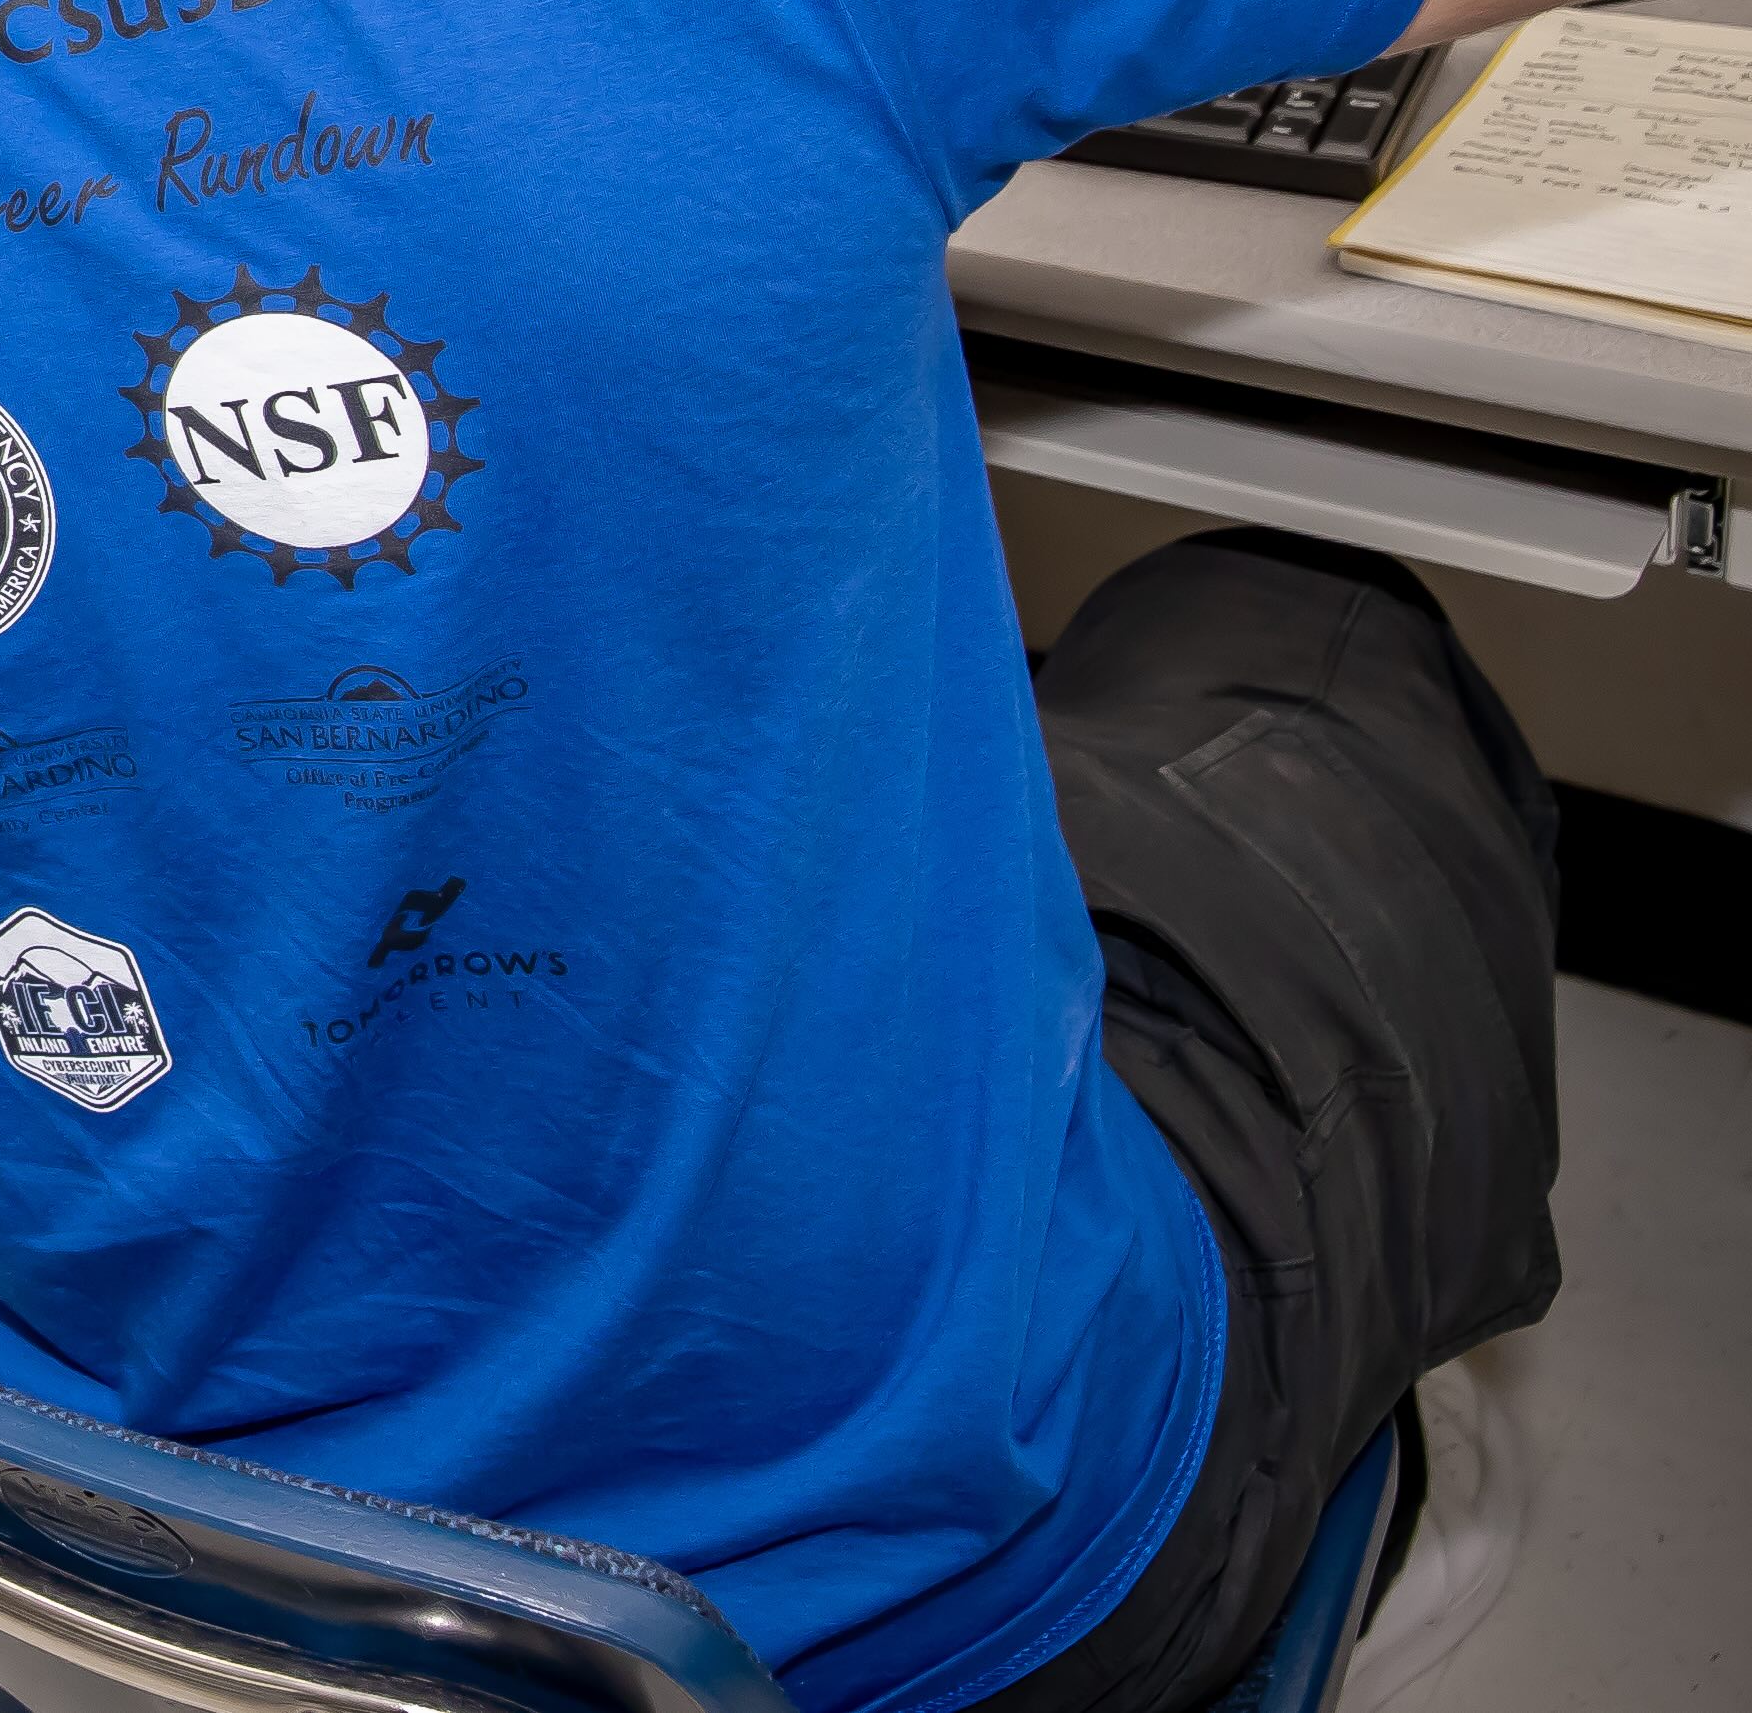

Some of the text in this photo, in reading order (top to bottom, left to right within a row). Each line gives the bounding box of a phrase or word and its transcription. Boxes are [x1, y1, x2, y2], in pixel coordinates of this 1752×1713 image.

[156, 90, 434, 212] Rundown
[167, 373, 407, 485] NSF
[230, 706, 344, 725] CALIFORNIA
[351, 706, 403, 722] STATE
[235, 676, 529, 752] SAN BERNARDINO
[13, 732, 130, 768] UNIVERSITY
[286, 767, 345, 787] Office
[348, 769, 368, 788] of
[299, 949, 569, 1049] TOMORROW'S
[18, 1035, 149, 1055] INLAND EMPIRE
[42, 1059, 132, 1074] CYBERSECURITY
